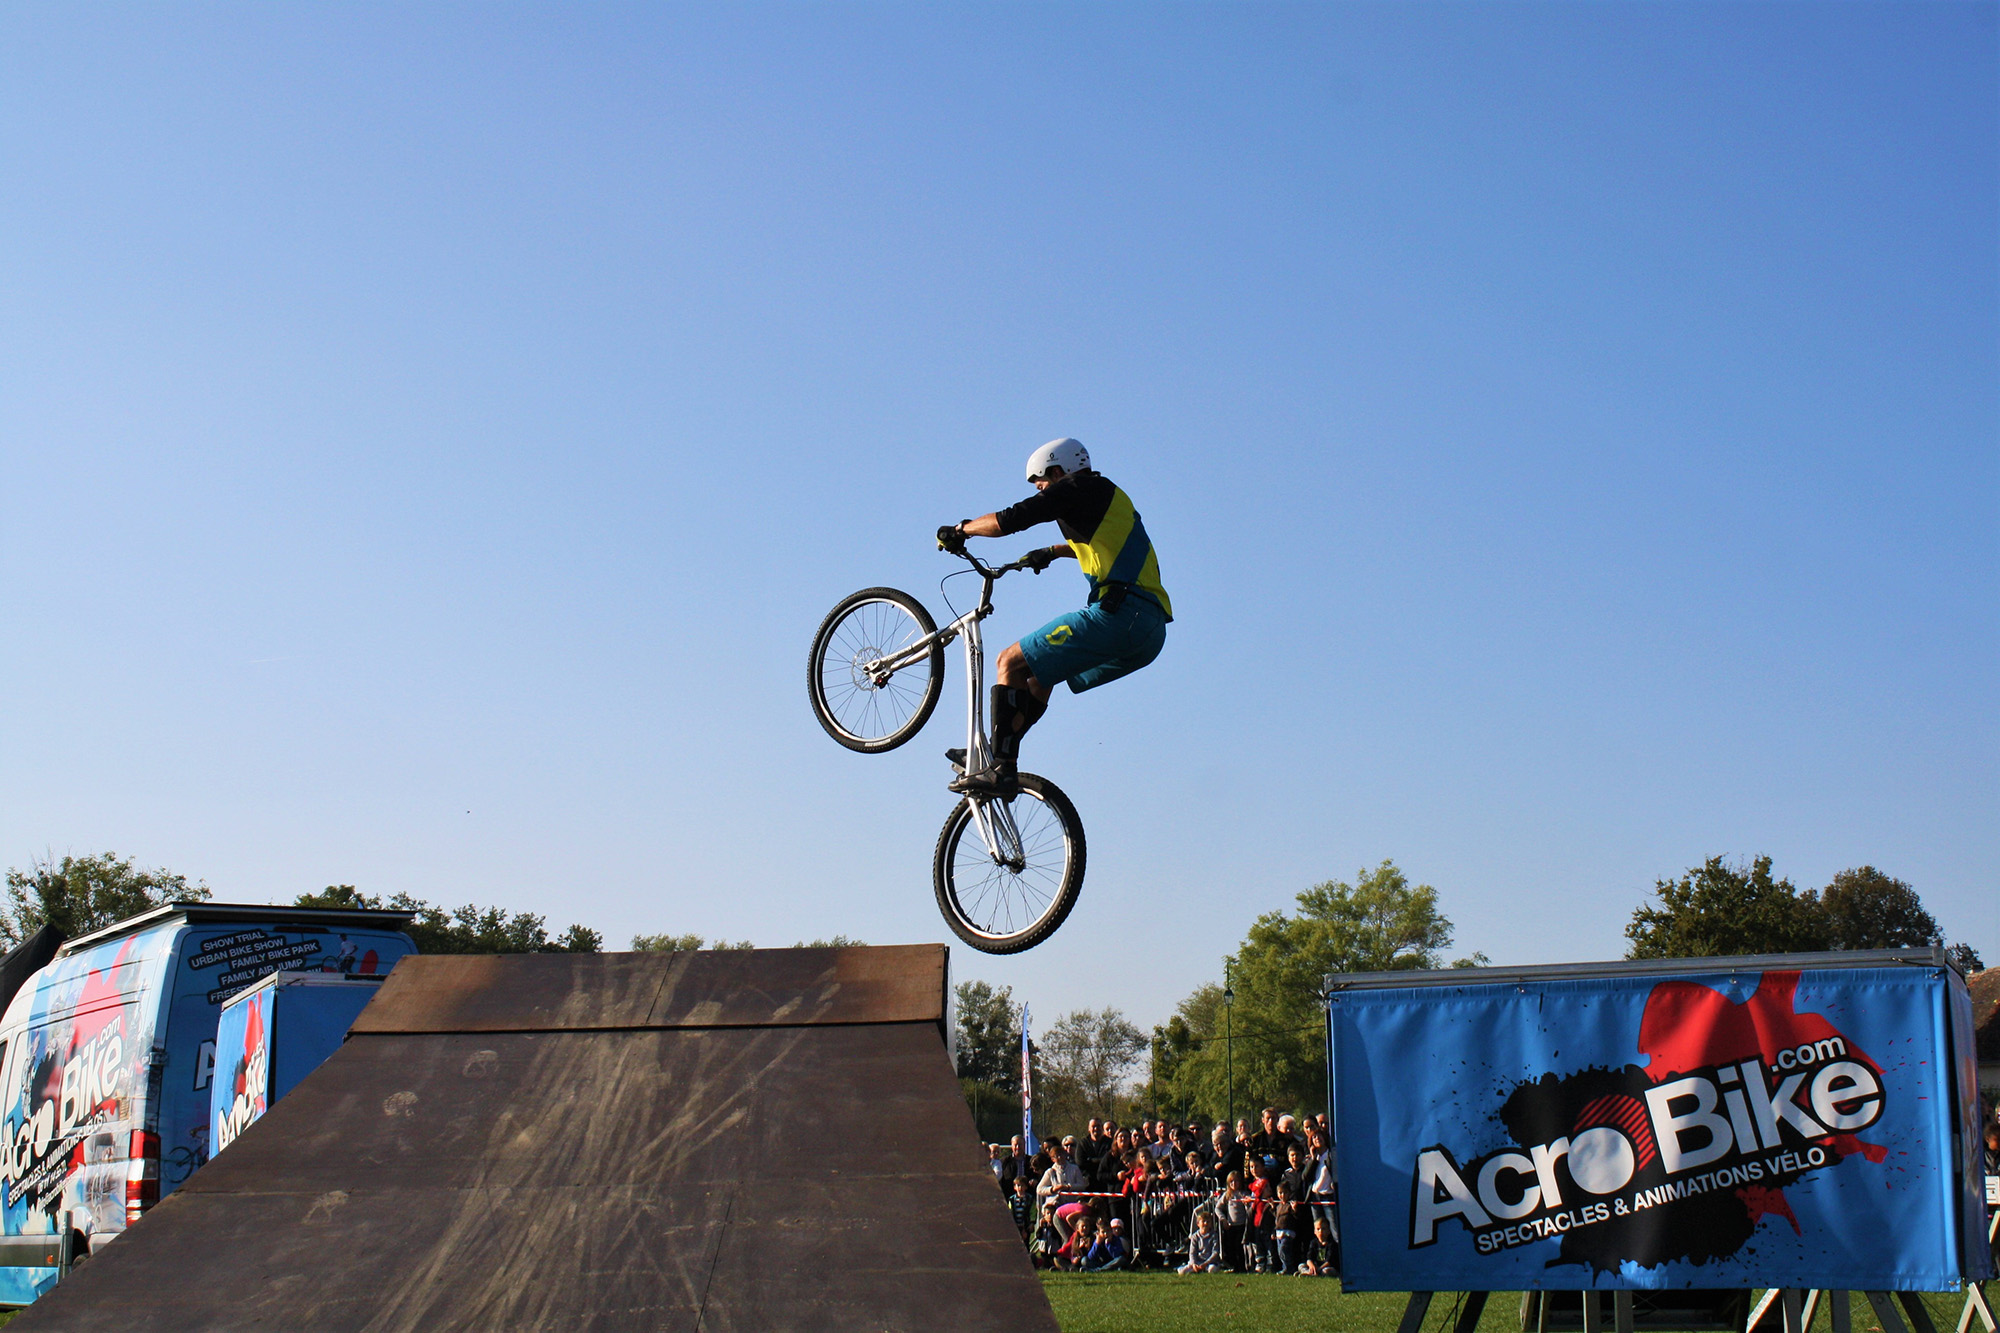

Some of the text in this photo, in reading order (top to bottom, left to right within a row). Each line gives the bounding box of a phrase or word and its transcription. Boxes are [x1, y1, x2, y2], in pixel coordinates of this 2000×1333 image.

[191, 939, 284, 968] URBAN BIKE SHOW
[203, 931, 265, 951] SHOW TRIAL
[231, 942, 318, 969] FAMILY BIKE PARK
[221, 968, 256, 986] FAMILY
[258, 964, 275, 977] AIR
[277, 958, 303, 972] JUMP
[1771, 1036, 1846, 1073] .com
[1478, 1146, 1825, 1252] SPECTACLES & ANIMATIONS VÉLO
